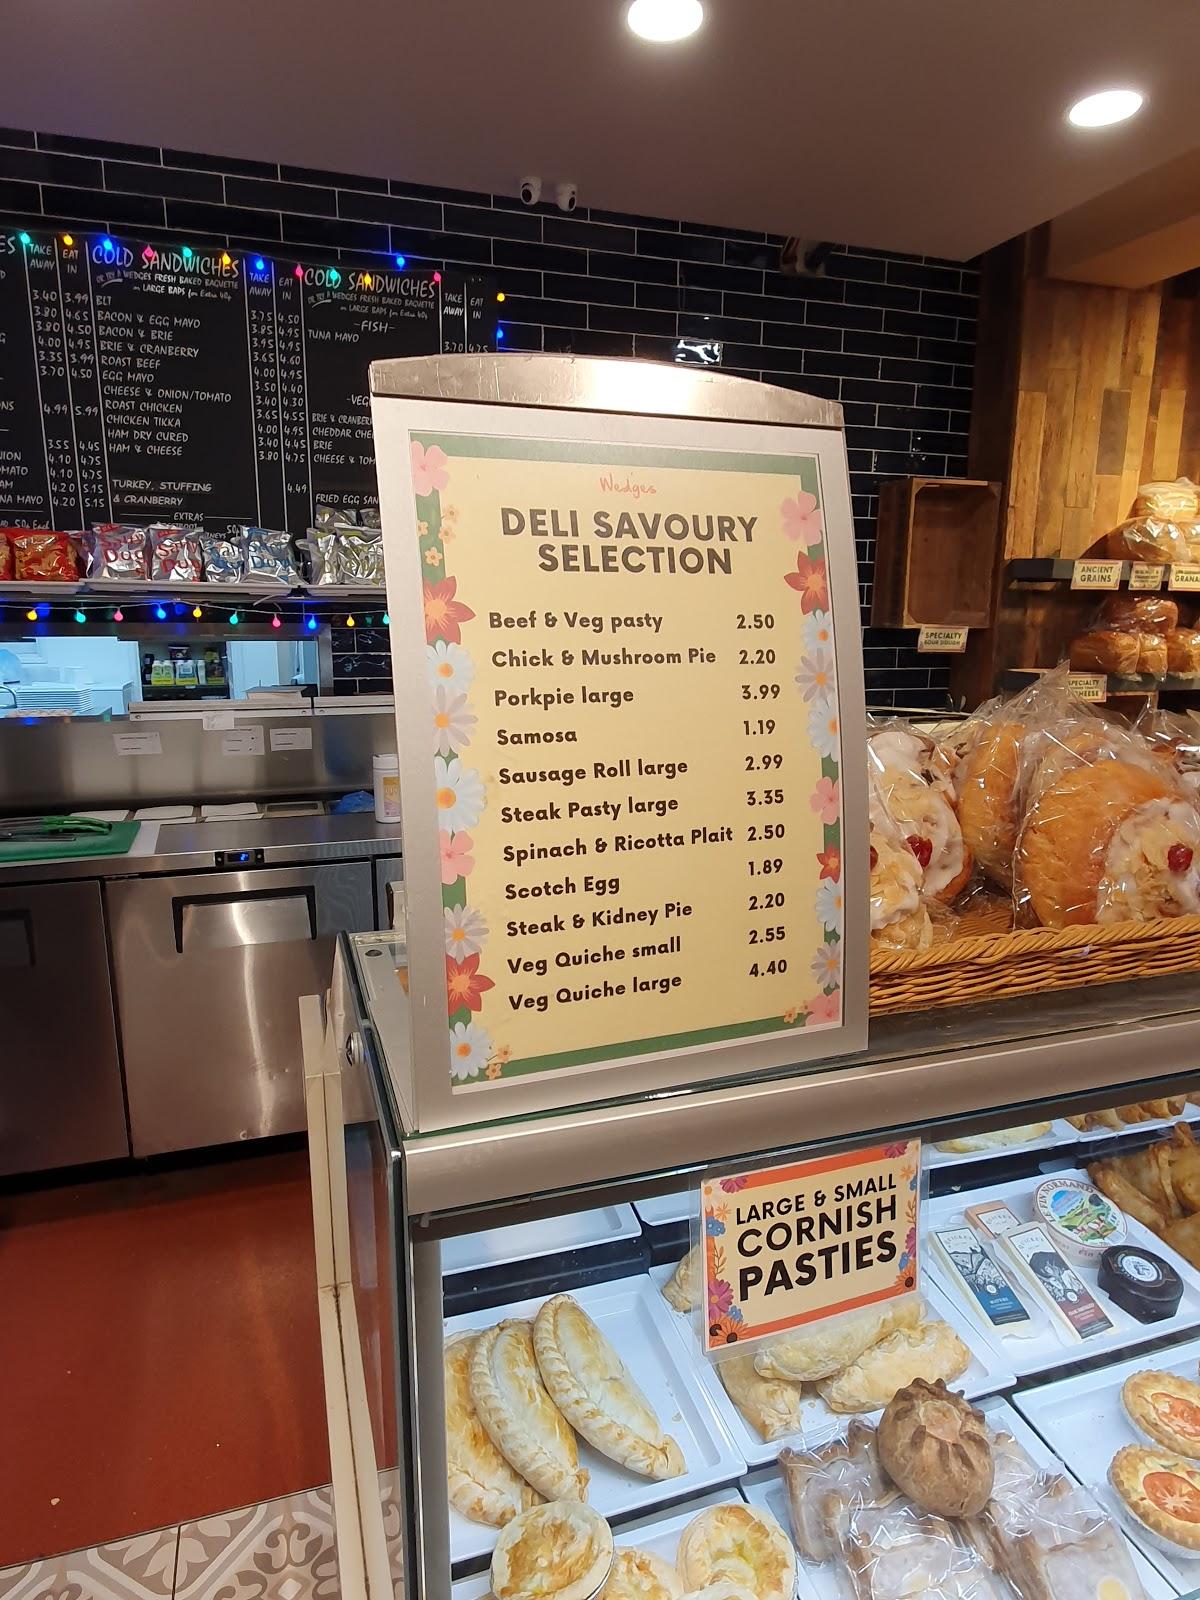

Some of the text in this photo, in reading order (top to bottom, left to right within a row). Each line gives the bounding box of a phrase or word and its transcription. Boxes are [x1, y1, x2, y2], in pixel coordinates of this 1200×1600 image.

[29, 243, 52, 256] TAKE
[62, 249, 79, 260] EAT
[30, 259, 78, 274] AWAY IN
[92, 245, 240, 279] COLD SANDWICHES
[123, 270, 239, 290] WEDGES FRESH BAKED BAGUETTE
[249, 272, 293, 287] TAKE EAT
[304, 268, 436, 299] COLD SANDWICHES
[32, 289, 89, 305] 3.40 3.99
[143, 284, 186, 296] LARGE BAPS
[249, 286, 292, 300] AWAY IN
[96, 294, 112, 306] BLT
[444, 293, 484, 307] TAKE EAT
[65, 308, 89, 321] 4.65
[97, 310, 132, 323] BACON
[149, 315, 170, 327] EGG
[173, 316, 201, 328] MAYO
[250, 309, 300, 324] 3.75 4.50
[443, 306, 481, 319] AWAY IN
[67, 323, 92, 335] 4.50
[99, 326, 133, 338] BACON
[151, 330, 173, 341] BRIE
[308, 329, 360, 343] TUNA MAYO
[100, 340, 123, 352] BRIE
[140, 344, 199, 358] CRANBERRY
[444, 341, 464, 352] 3.70
[101, 355, 161, 370] ROAST BEEF
[253, 351, 301, 365] 3.65 4.60
[40, 365, 94, 379] 3.70 4.50
[102, 370, 154, 383] EGG MAYO
[103, 385, 141, 397] CHEESE
[157, 388, 232, 403] ONION/TOMATO
[255, 381, 303, 394] 3.50 4.40
[44, 403, 98, 417] 4.99 5.99
[105, 399, 183, 414] ROAST CHICKEN
[106, 414, 181, 428] CHICKEN TIKKA
[256, 408, 305, 422] 3.65 4.55
[312, 412, 327, 423] BRIE
[108, 429, 189, 443] HAM DRY CURED
[312, 427, 352, 438] CHEDDAR
[47, 439, 100, 451] 3.55 4.45
[109, 443, 130, 453] HAM
[146, 445, 183, 456] CHEESE
[313, 440, 333, 450] BRIE
[258, 450, 306, 463] 3.80 4.75
[314, 454, 345, 464] CHEESE
[160, 481, 212, 493] STUFFING
[599, 476, 657, 498] Wedges
[113, 494, 184, 506] & CRANBERRY
[315, 493, 340, 503] FRIED
[343, 495, 360, 505] EGG
[173, 511, 204, 522] EXTRAS
[500, 508, 757, 542] DELI SAVOURY
[538, 544, 731, 574] SELECTION
[1080, 574, 1112, 583] GRAINS
[489, 611, 774, 633] Beef & Veg pasty 2.50
[925, 631, 962, 639] SPECIALTY
[491, 648, 775, 667] Chick & Mushroom Pie 2.20
[494, 684, 780, 710] Porkpie large 3.99
[497, 720, 775, 745] Samosa 1.19
[498, 755, 782, 786] Sausage Roll large 2.99
[501, 790, 783, 823] Steak Pasty large 3.35
[503, 824, 784, 866] Spinach & Ricotta Plait 2.50
[505, 859, 782, 899] Scotch Egg 1.89
[506, 893, 784, 936] Steak & Kidney Pie 2.20
[506, 926, 785, 975] Veg Quiche small 2.55
[508, 960, 787, 1012] Veg Quiche large 4.40
[736, 1173, 897, 1226] LARGE & SMALL
[737, 1194, 897, 1258] CORNISH
[739, 1230, 897, 1302] PASTIES
